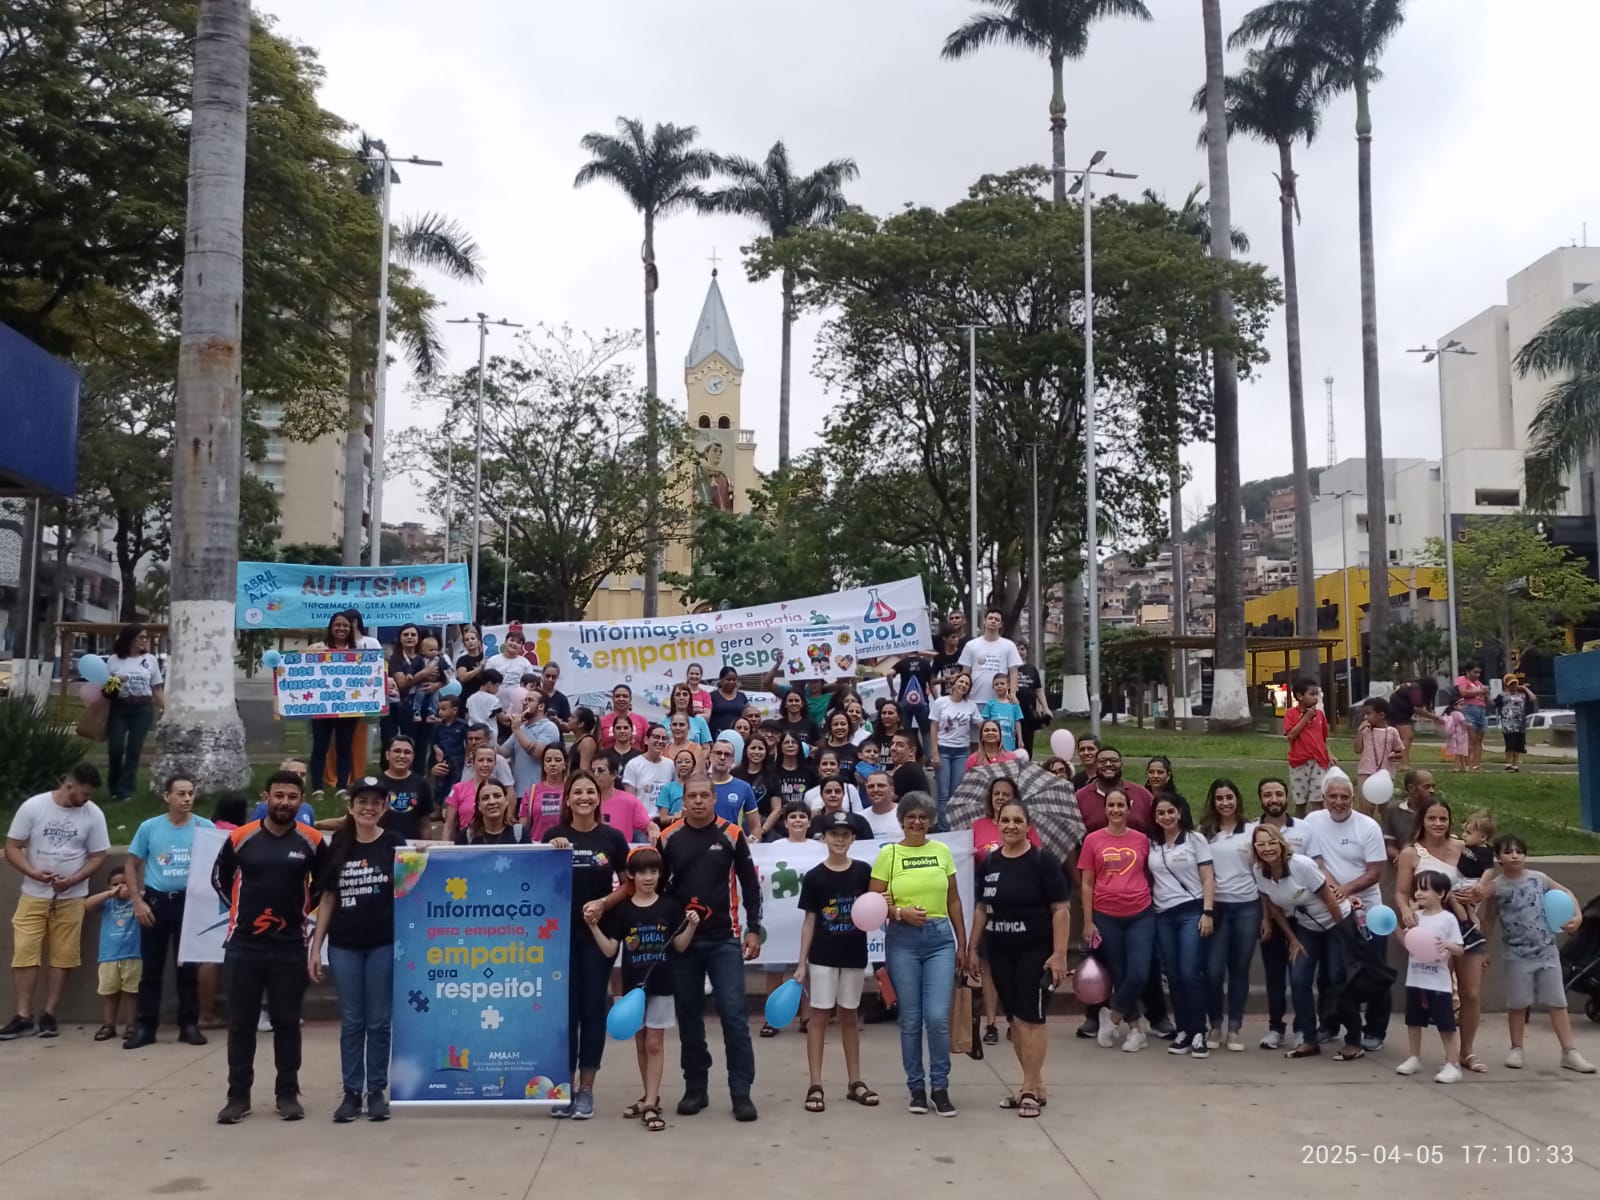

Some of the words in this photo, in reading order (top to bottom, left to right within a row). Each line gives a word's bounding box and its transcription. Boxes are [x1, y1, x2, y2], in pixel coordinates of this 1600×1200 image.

[244, 569, 277, 593] ABRIL
[301, 575, 427, 597] AUTISMO
[249, 580, 282, 604] AZUL
[365, 602, 386, 610] GERA
[390, 601, 421, 610] EMPATIA
[311, 612, 331, 620] EMPA
[714, 621, 744, 634] gera
[746, 613, 806, 629] empatia.
[579, 619, 709, 645] Informação
[720, 637, 753, 653] gera
[855, 643, 884, 655] boratório
[884, 642, 892, 650] de
[284, 654, 302, 664] AS
[305, 652, 379, 665] DIFERENÇAS
[592, 638, 716, 672] empatia
[722, 647, 783, 668] respe
[288, 666, 315, 677] NOS
[320, 665, 373, 676] TORNAM
[332, 678, 342, 687] O
[320, 691, 346, 701] NOS
[284, 703, 327, 714] TORNA
[903, 857, 938, 867] Brooklyn
[341, 896, 357, 907] TEA
[427, 900, 545, 920] Informação
[427, 926, 460, 940] gera
[465, 924, 529, 938] empatia,
[995, 919, 1027, 932] ATÍPICA
[427, 941, 544, 969] empatia
[427, 968, 458, 981] gera
[436, 977, 542, 1003] respeito!
[489, 1051, 520, 1060] AMAAM
